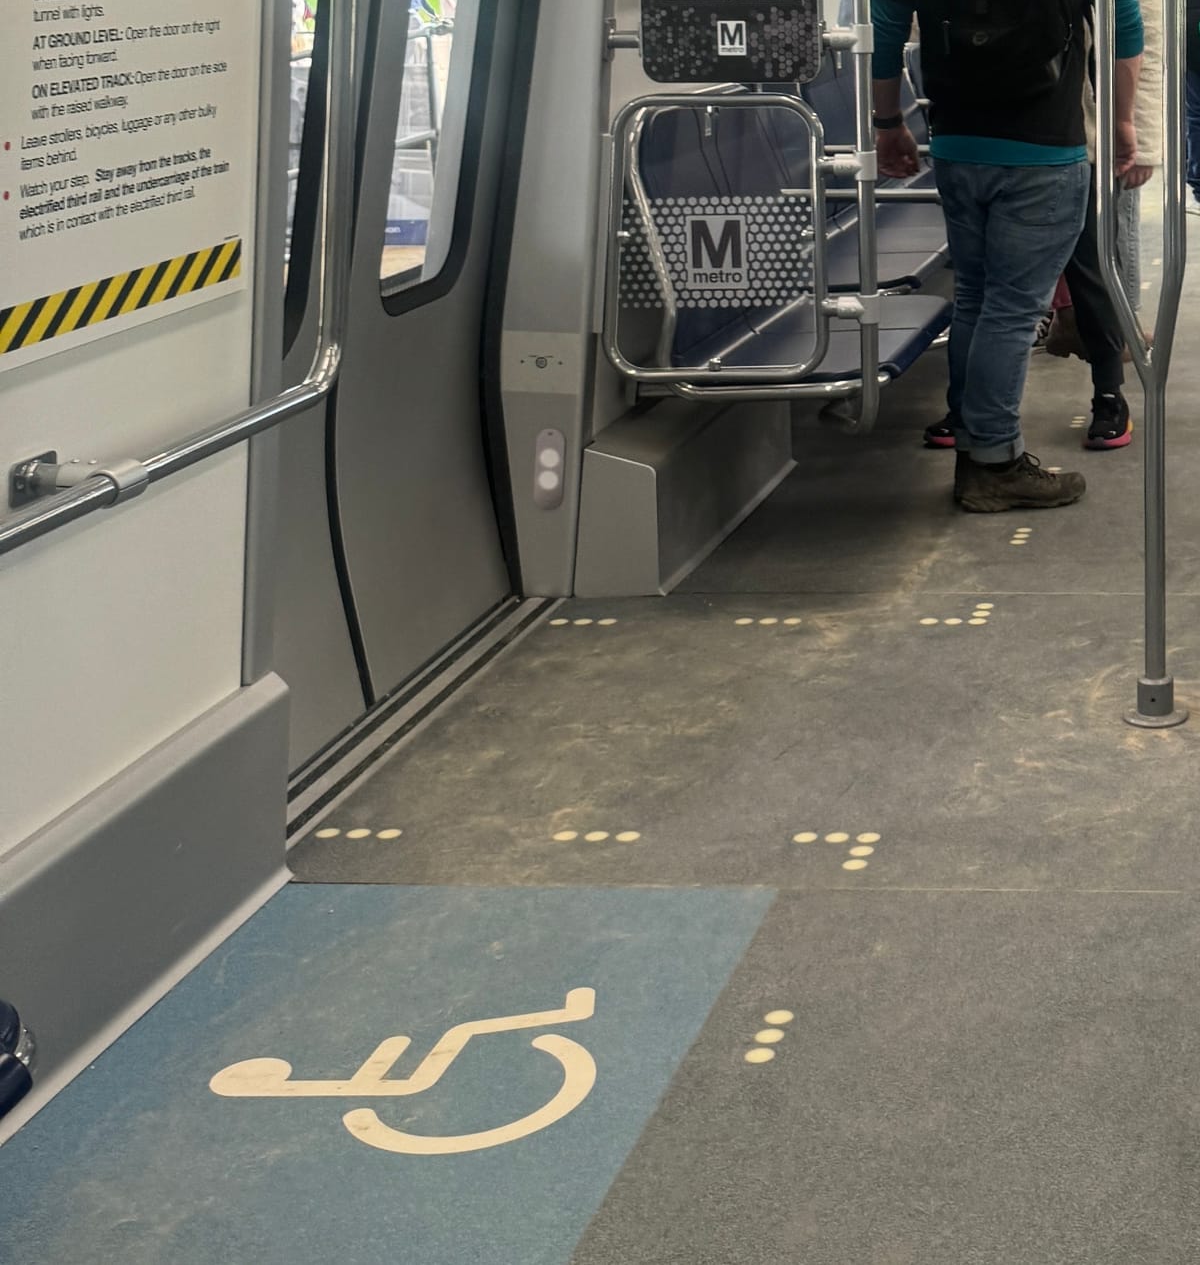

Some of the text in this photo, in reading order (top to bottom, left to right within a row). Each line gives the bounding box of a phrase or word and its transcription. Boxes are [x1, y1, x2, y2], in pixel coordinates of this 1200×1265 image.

[720, 23, 744, 46] M
[691, 220, 742, 268] M
[693, 271, 743, 284] metro
